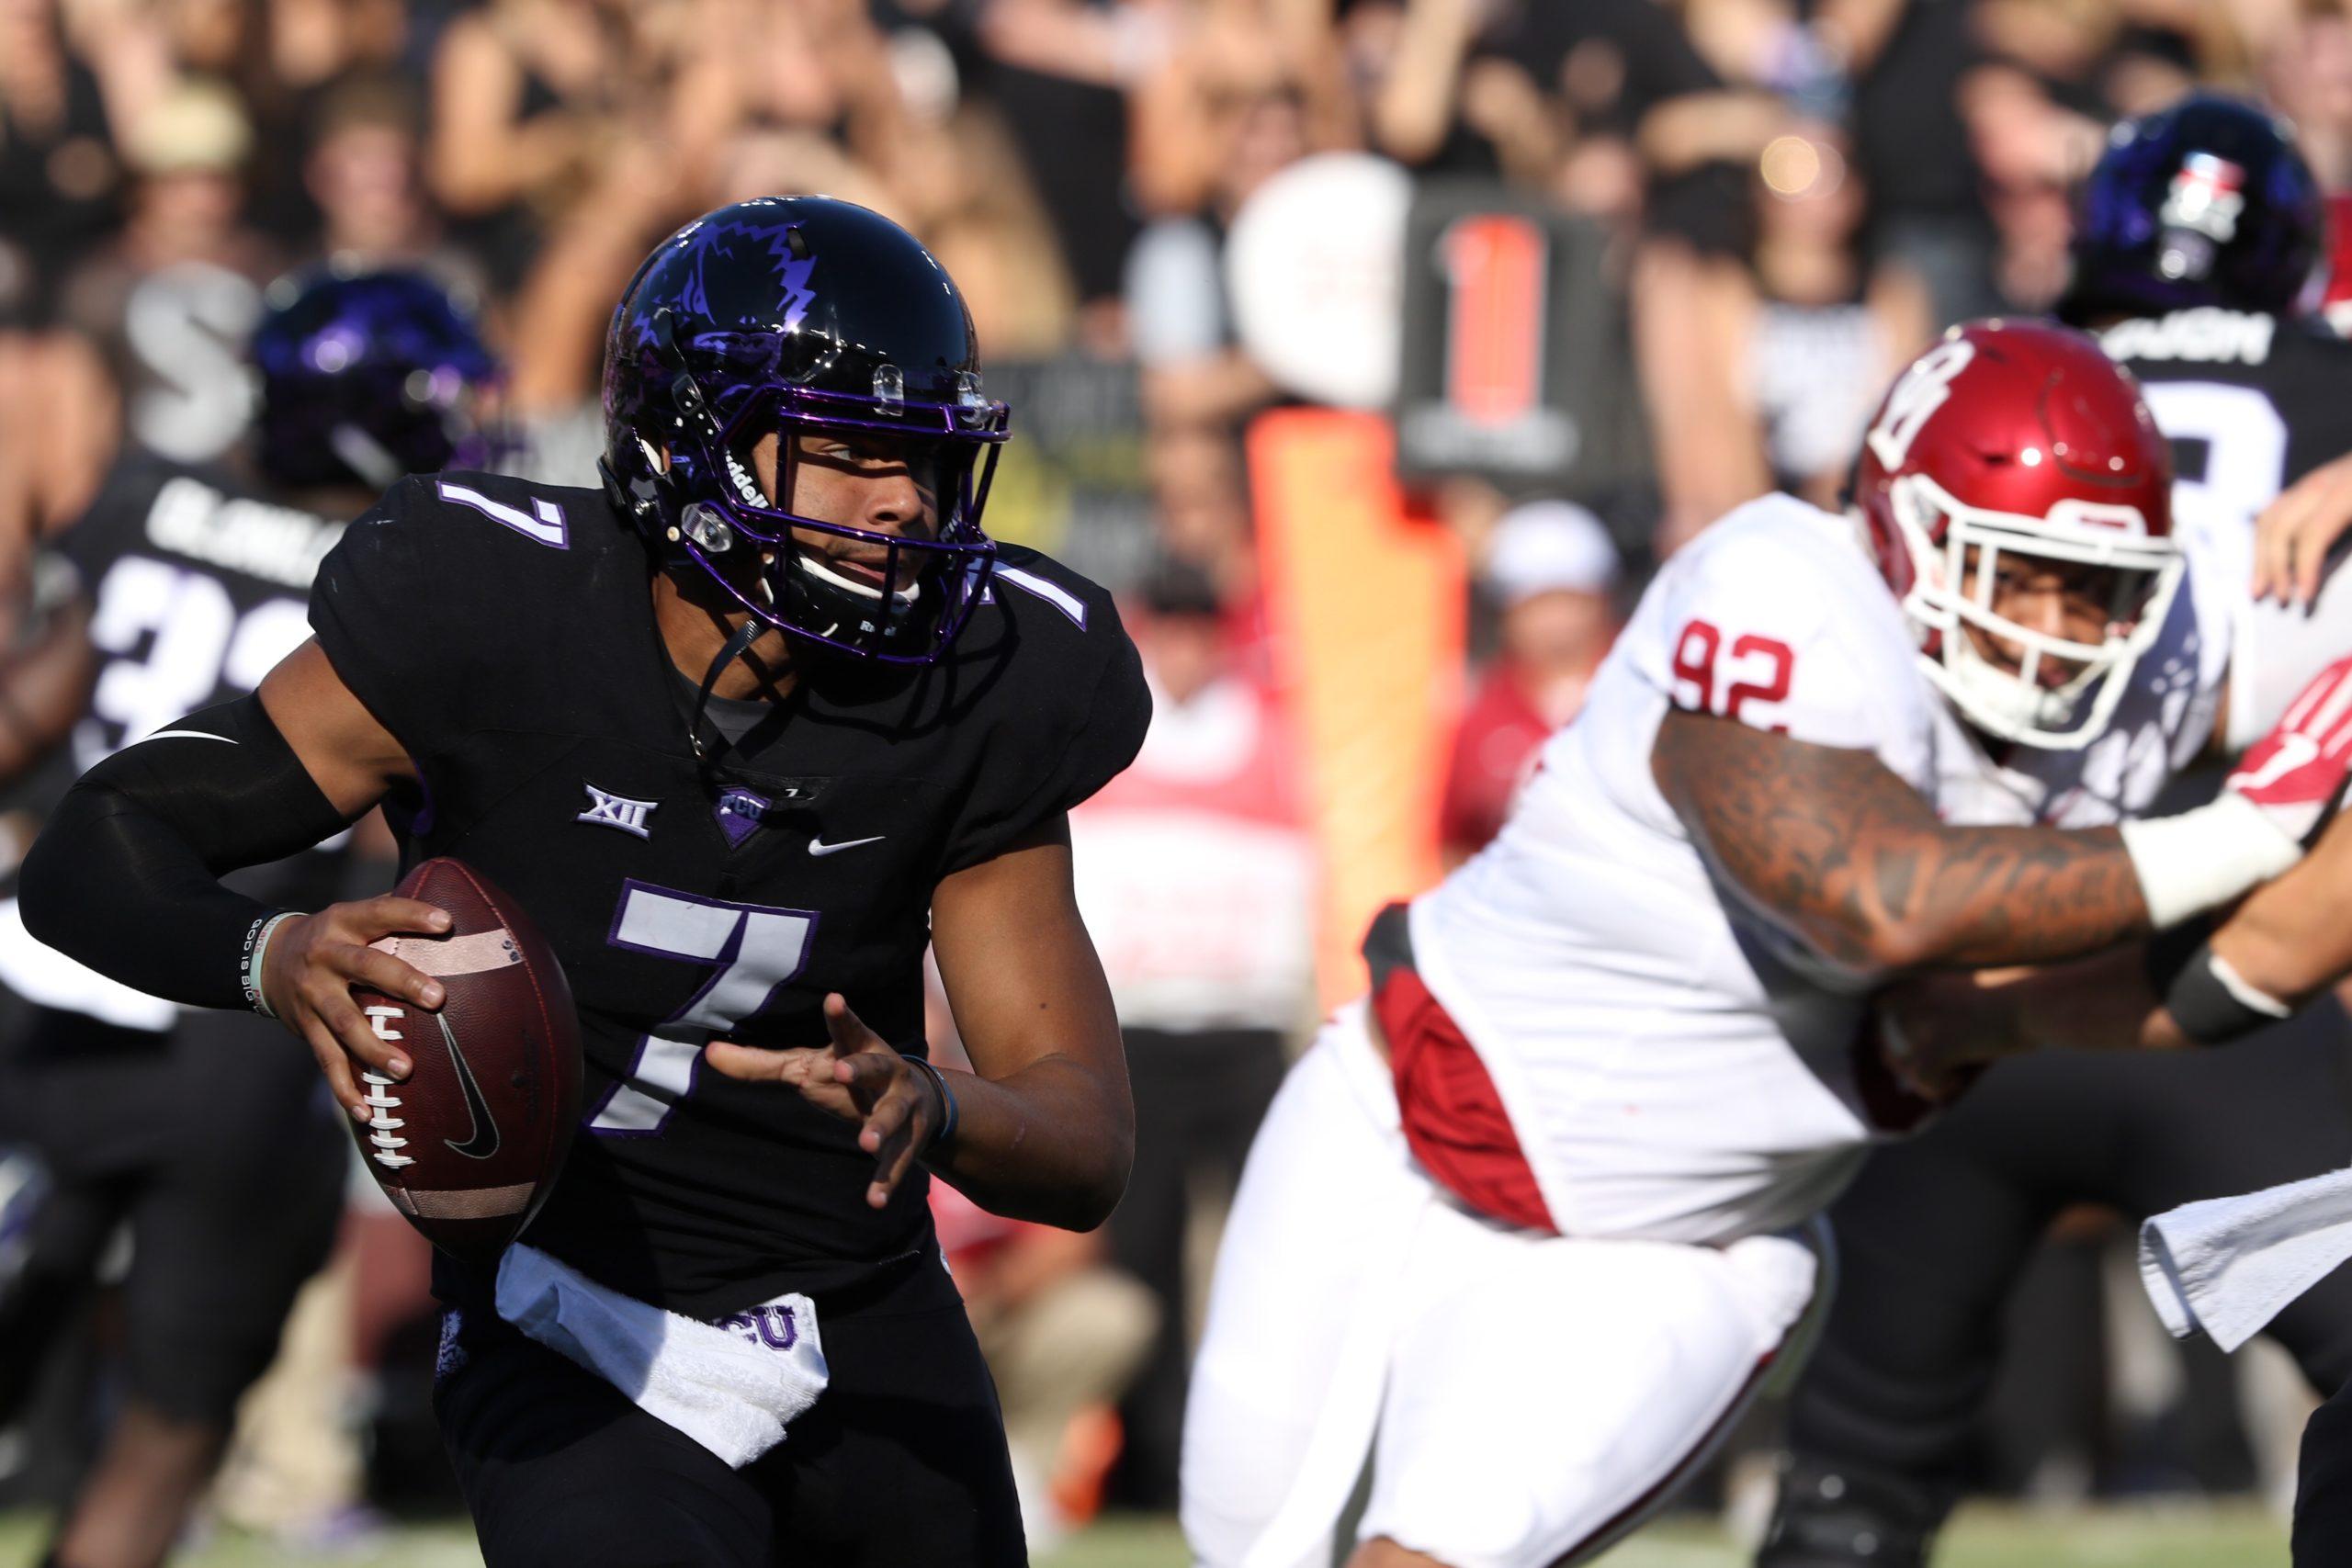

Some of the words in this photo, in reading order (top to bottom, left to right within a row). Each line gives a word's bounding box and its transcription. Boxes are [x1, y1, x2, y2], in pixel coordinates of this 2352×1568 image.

[435, 479, 571, 550] 7
[1673, 619, 1793, 738] 92
[575, 783, 659, 840] XII
[241, 956, 249, 971] IS
[243, 919, 263, 951] GOD
[582, 877, 821, 1137] 7
